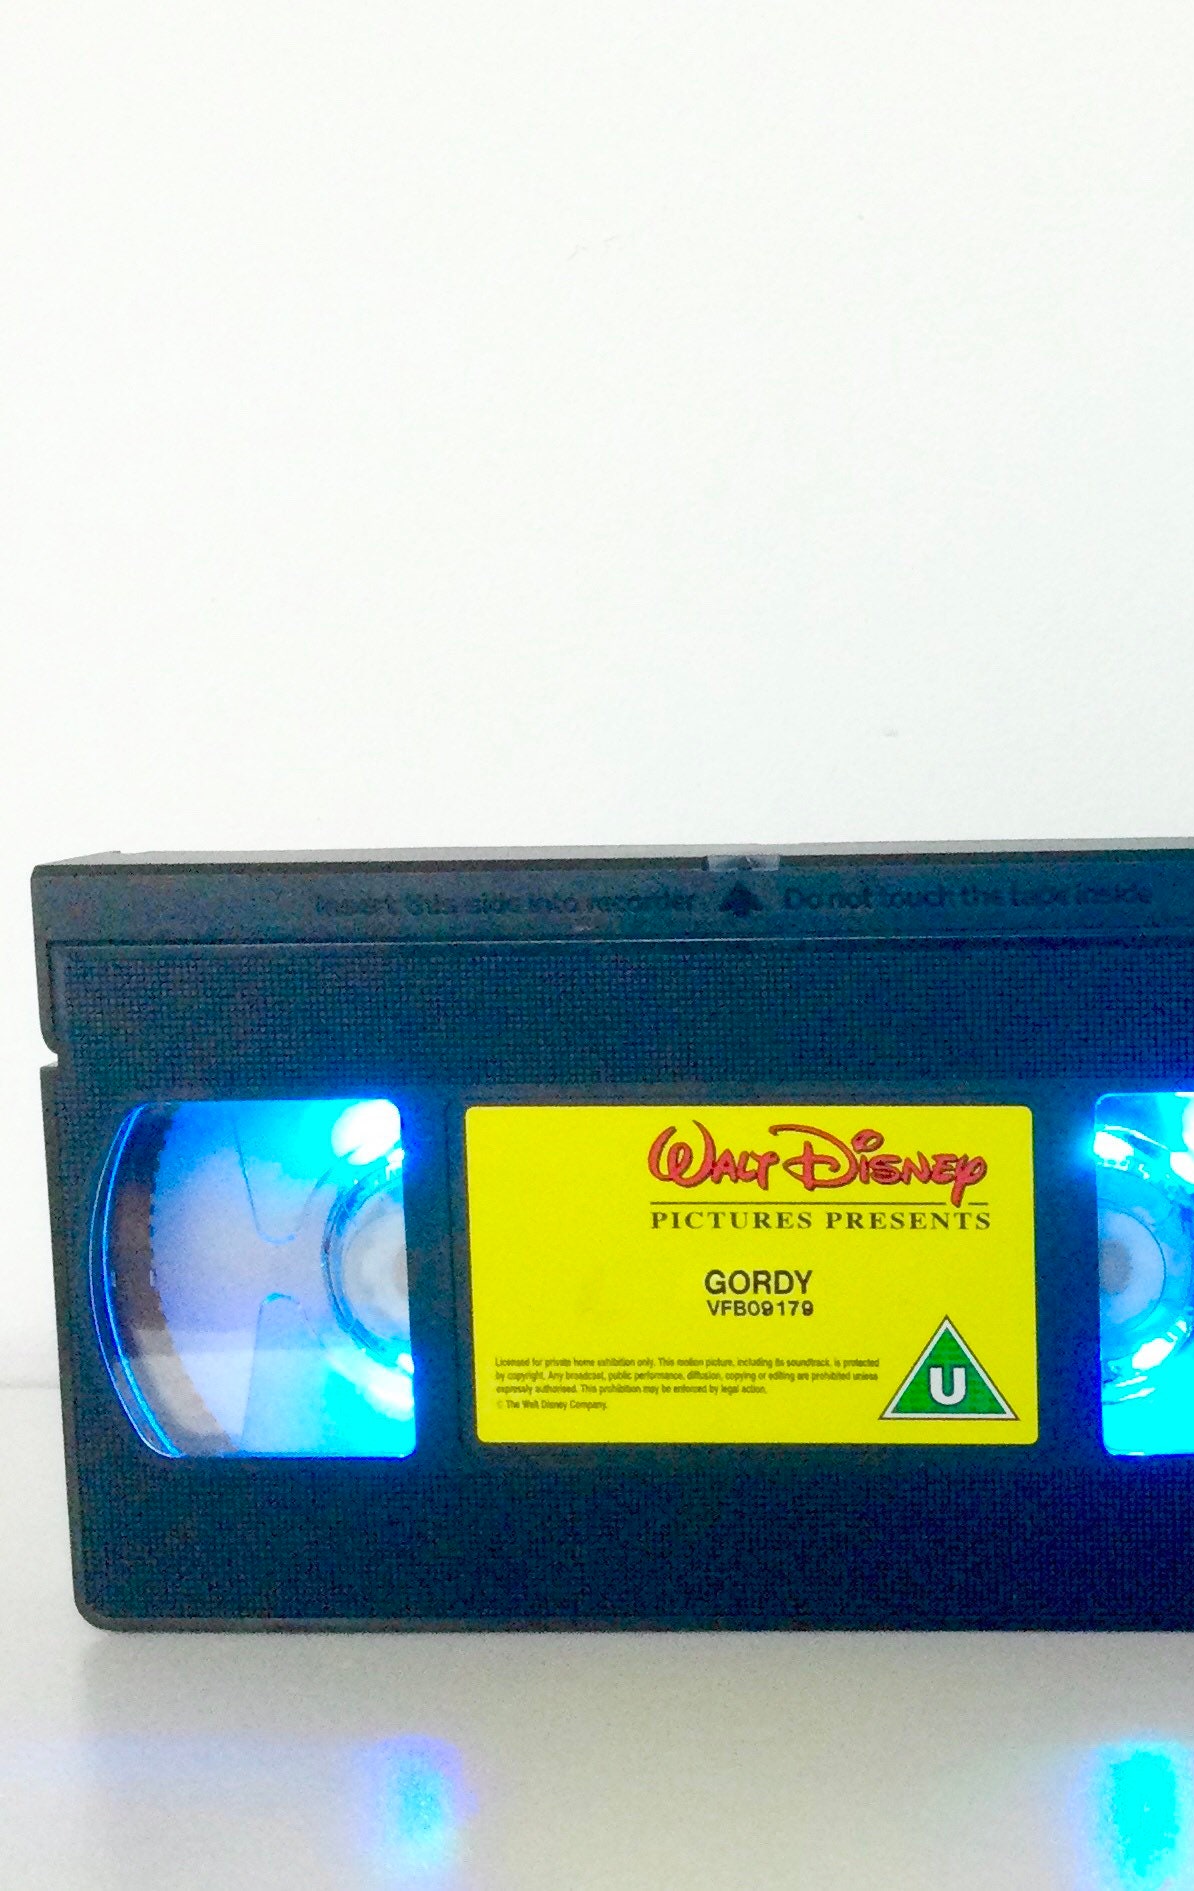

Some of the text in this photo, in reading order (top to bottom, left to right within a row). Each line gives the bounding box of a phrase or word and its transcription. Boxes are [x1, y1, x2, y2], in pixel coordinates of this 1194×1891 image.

[650, 1211, 991, 1230] PICTURES PRESENTS
[704, 1269, 813, 1295] GORDY
[706, 1299, 814, 1316] VFB09179
[531, 1357, 543, 1367] for
[574, 1357, 595, 1367] home
[930, 1367, 966, 1406] U
[505, 1400, 520, 1409] The
